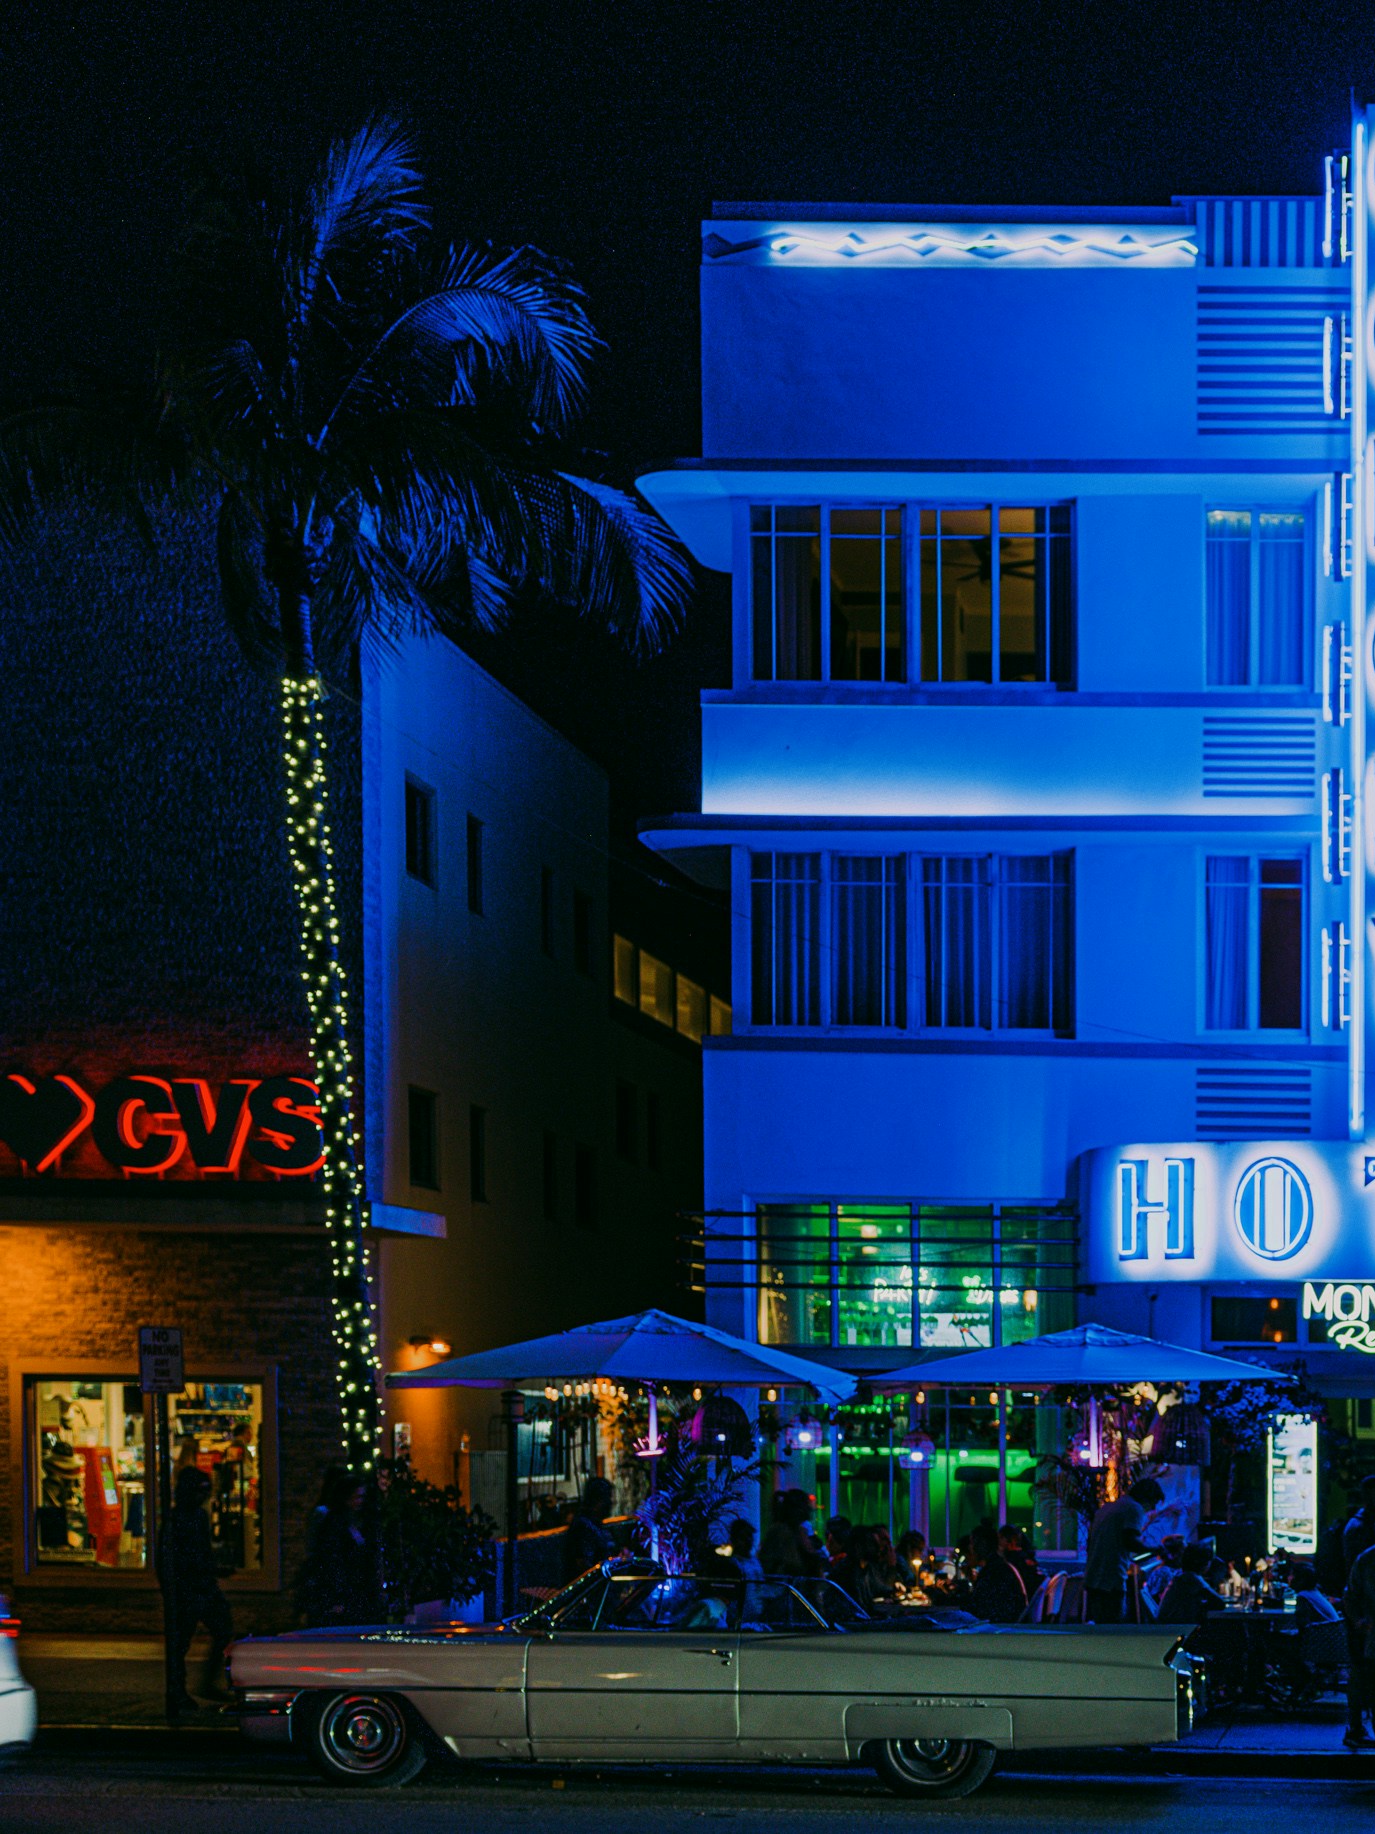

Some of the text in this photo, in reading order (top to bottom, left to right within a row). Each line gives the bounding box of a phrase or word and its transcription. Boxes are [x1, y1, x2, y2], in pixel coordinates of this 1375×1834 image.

[92, 1074, 326, 1175] CVS
[152, 1330, 169, 1342] NO
[142, 1344, 180, 1356] PARKING
